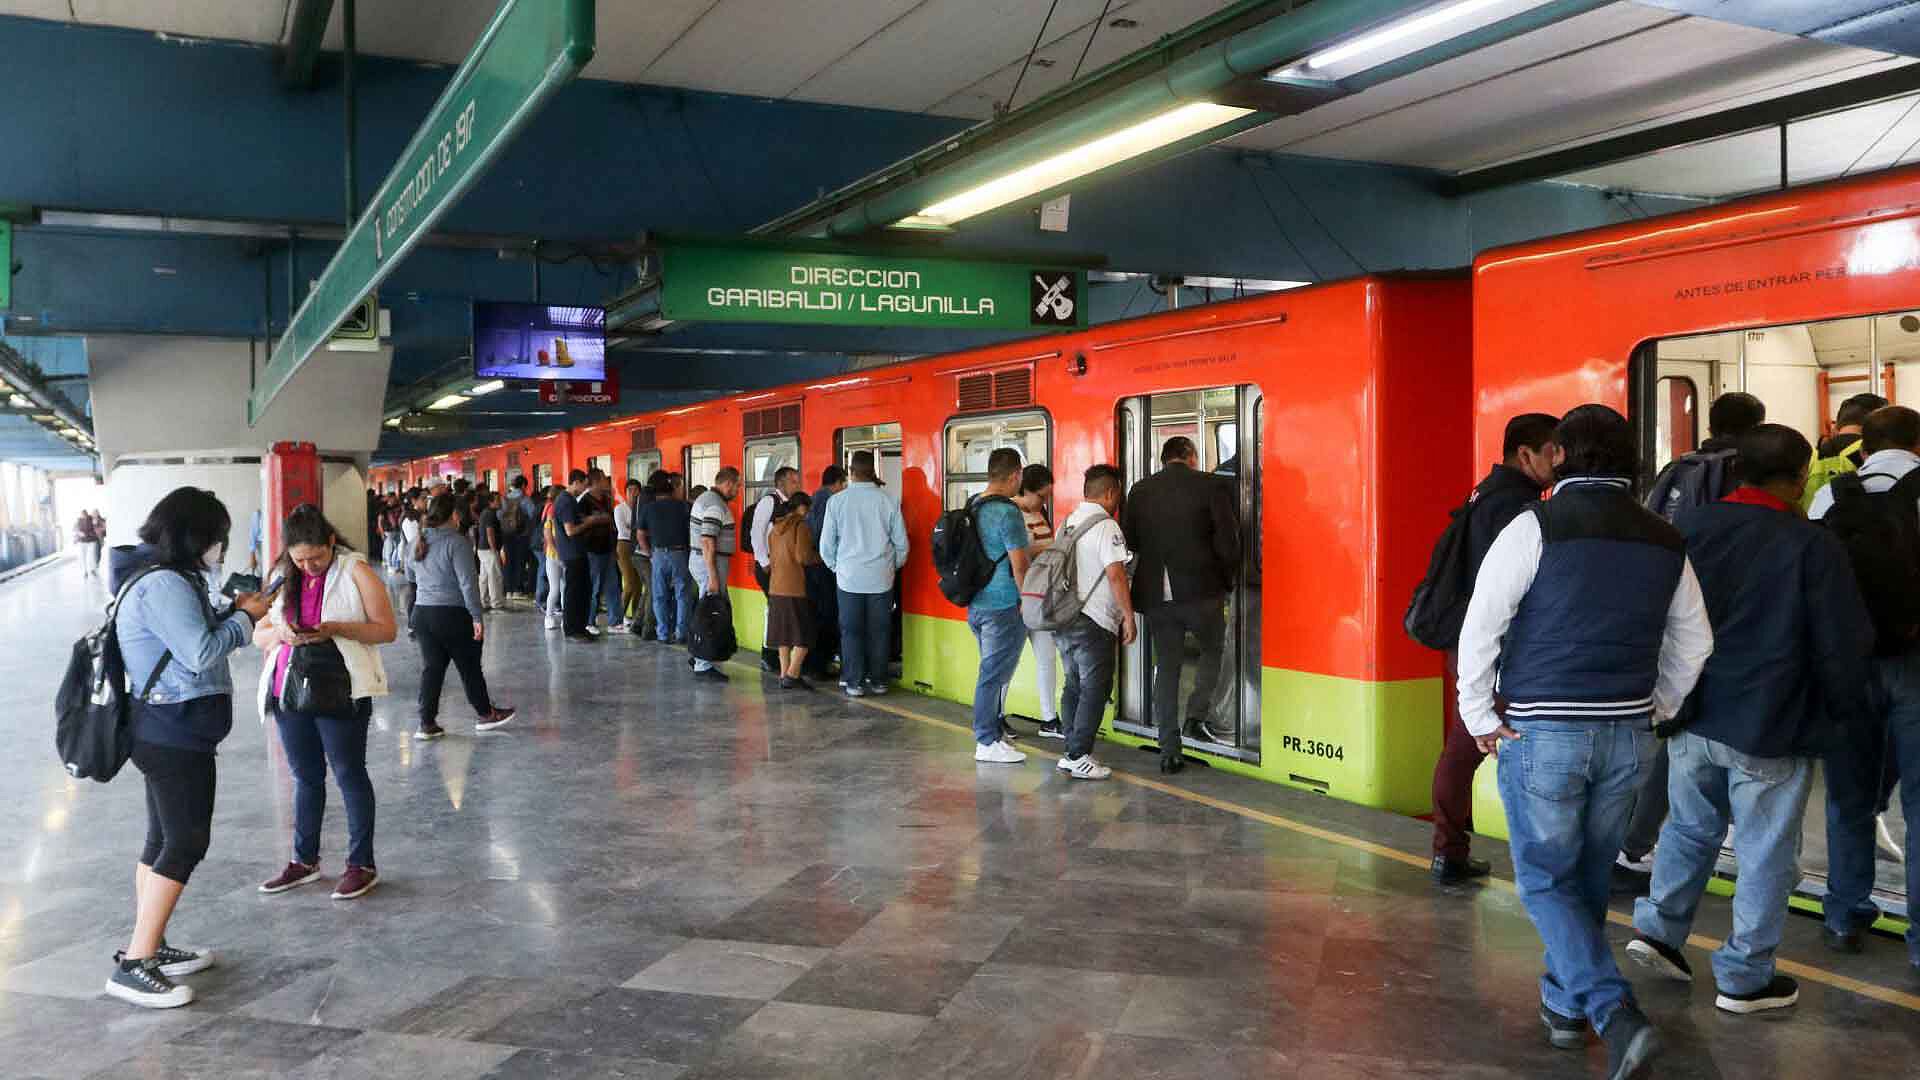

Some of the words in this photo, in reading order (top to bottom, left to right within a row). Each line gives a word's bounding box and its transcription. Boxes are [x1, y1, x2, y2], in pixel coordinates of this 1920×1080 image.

[437, 130, 452, 177] DE
[455, 98, 476, 155] 1917
[791, 266, 921, 289] DIRECCION
[1674, 286, 1721, 299] ANTES
[1724, 282, 1745, 294] DE
[1747, 271, 1812, 290] ENTRAR
[707, 287, 843, 311] GARIBALDI
[848, 293, 856, 311] /
[860, 293, 995, 315] LAGUNILLA
[1282, 735, 1344, 762] PR.3604
